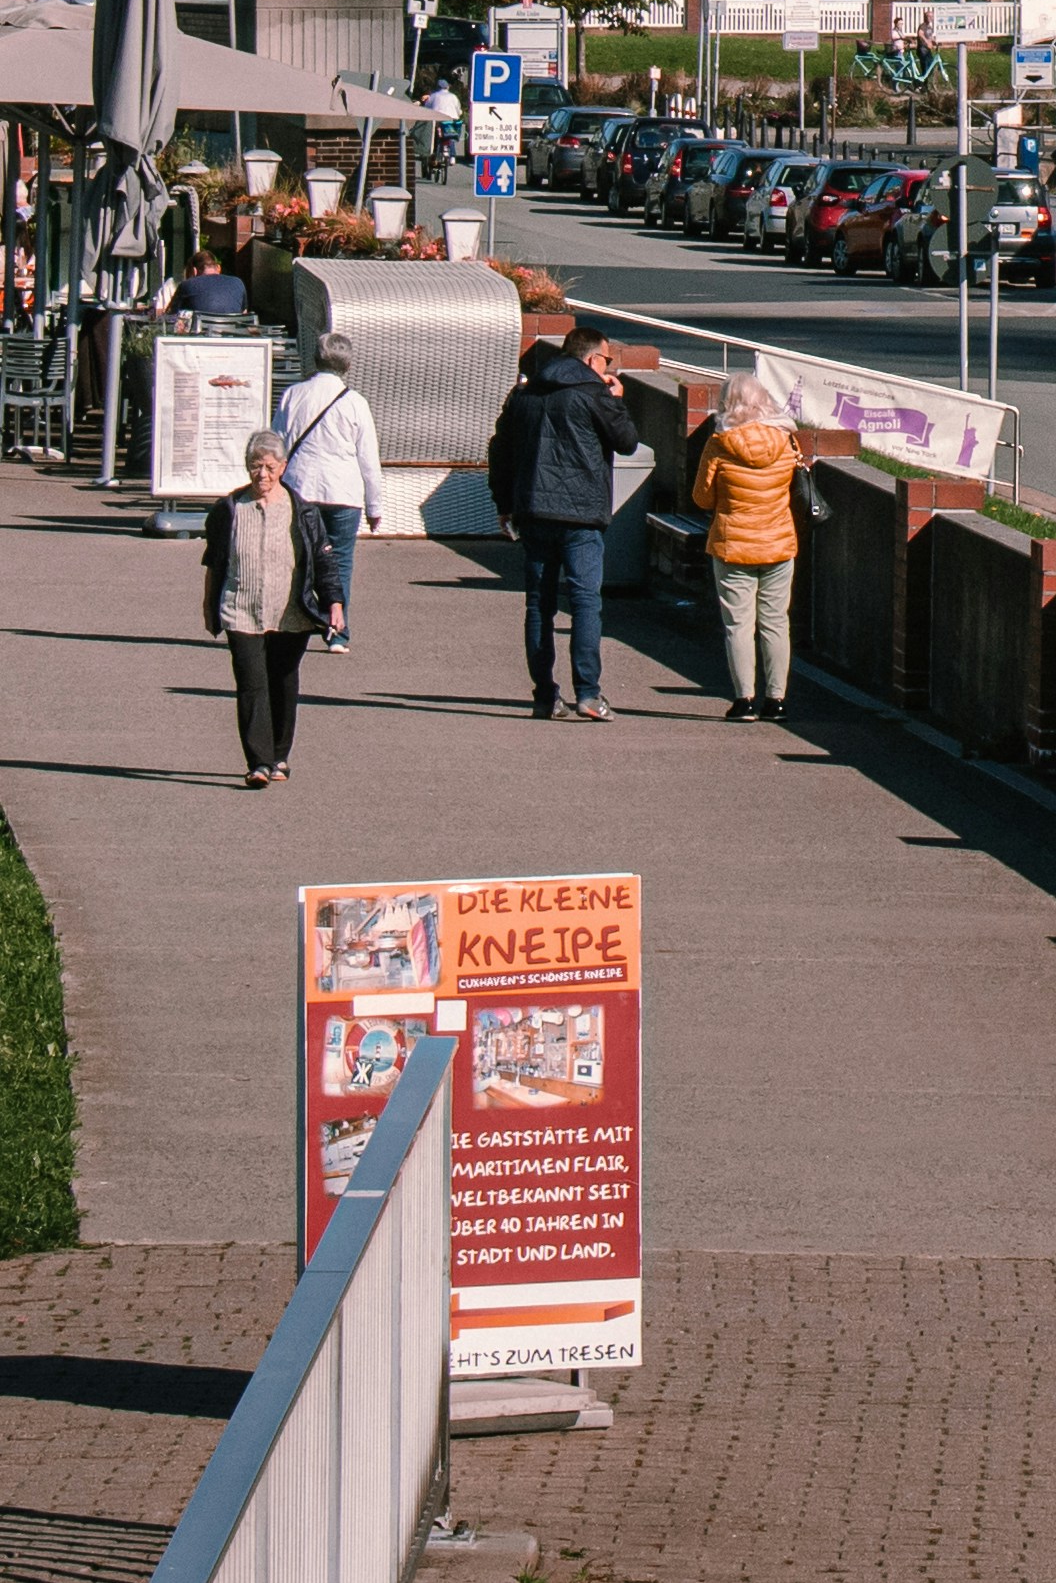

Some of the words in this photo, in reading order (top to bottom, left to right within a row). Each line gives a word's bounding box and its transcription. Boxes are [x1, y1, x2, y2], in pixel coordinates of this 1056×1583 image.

[483, 59, 511, 98] P
[484, 124, 494, 132] Tag
[823, 378, 849, 390] Letztes
[857, 418, 901, 432] Agnoli
[905, 446, 920, 456] New
[921, 450, 937, 458] York
[458, 887, 512, 915] DIE
[520, 884, 634, 913] KLEINE
[457, 924, 628, 968] KNEIPE
[584, 967, 624, 980] KNEIPE
[477, 1126, 590, 1148] GASTSTÄTTE
[593, 1125, 634, 1144] MIT
[452, 1157, 571, 1179] MARITIMEN
[574, 1154, 630, 1174] FLAIR,
[587, 1183, 631, 1201] SEIT
[500, 1217, 521, 1233] 40
[525, 1212, 598, 1233] JAHREN
[601, 1211, 625, 1229] IN
[456, 1248, 513, 1266] STADT
[516, 1244, 557, 1263] UND
[560, 1242, 617, 1261] LAND.
[505, 1348, 554, 1365] ZUM
[558, 1343, 635, 1363] TRESEN
